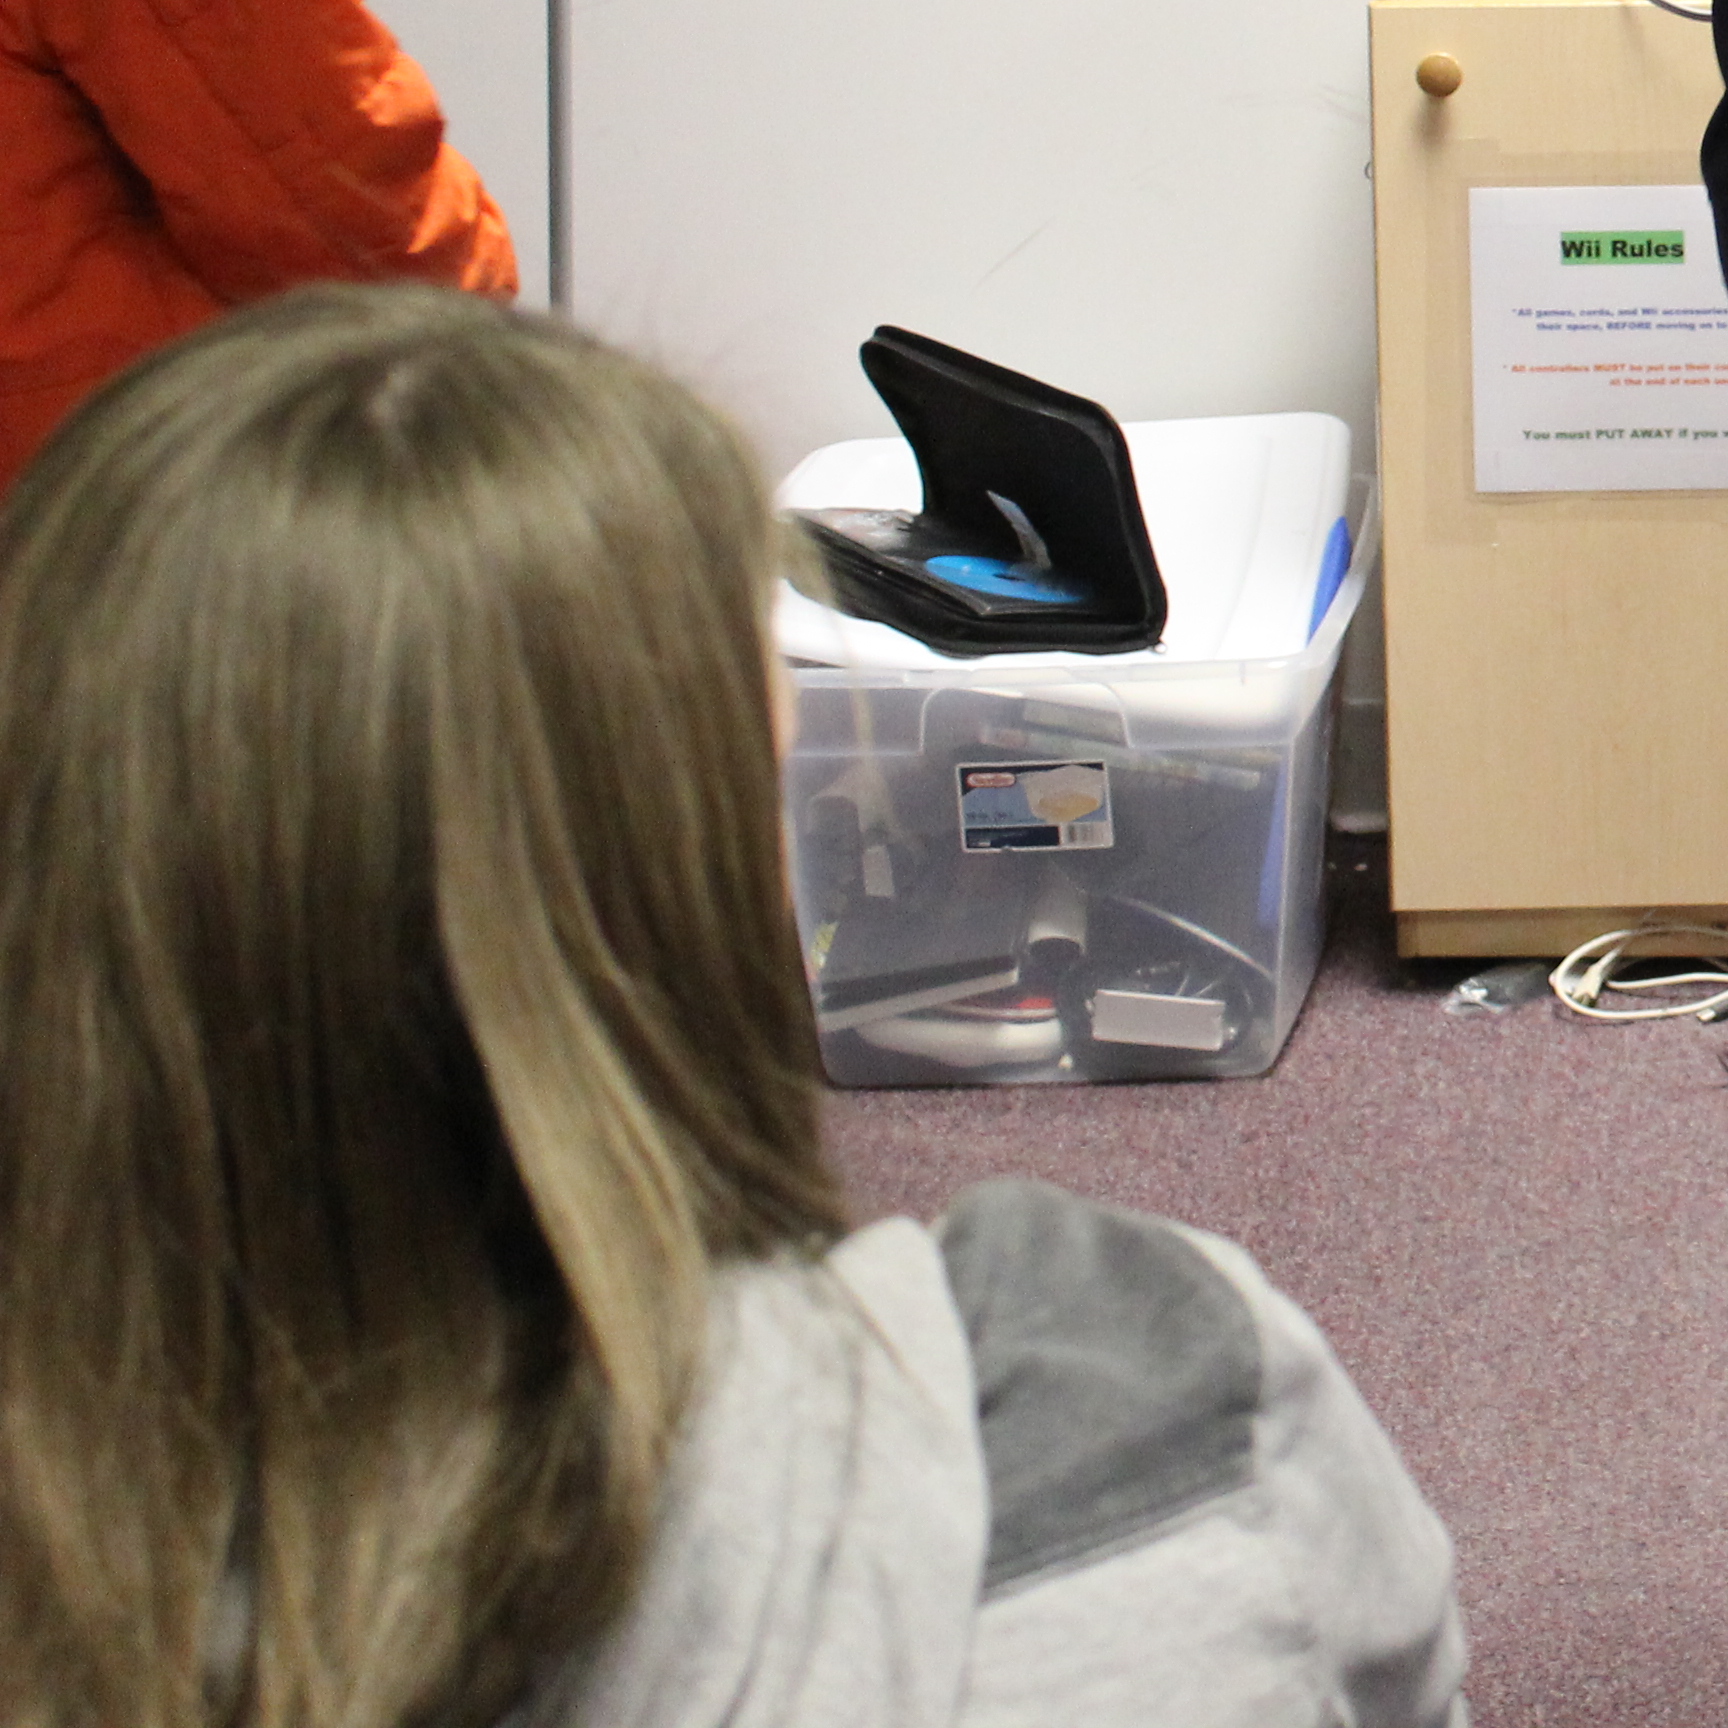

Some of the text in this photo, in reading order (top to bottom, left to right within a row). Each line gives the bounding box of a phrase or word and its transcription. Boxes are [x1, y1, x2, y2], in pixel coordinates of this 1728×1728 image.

[1560, 239, 1684, 258] Wii Rules
[1522, 429, 1551, 440] You
[1554, 429, 1592, 439] must
[1594, 428, 1626, 439] PUT
[1629, 428, 1674, 438] AWAY
[1678, 427, 1689, 438] if
[1692, 429, 1718, 441] you
